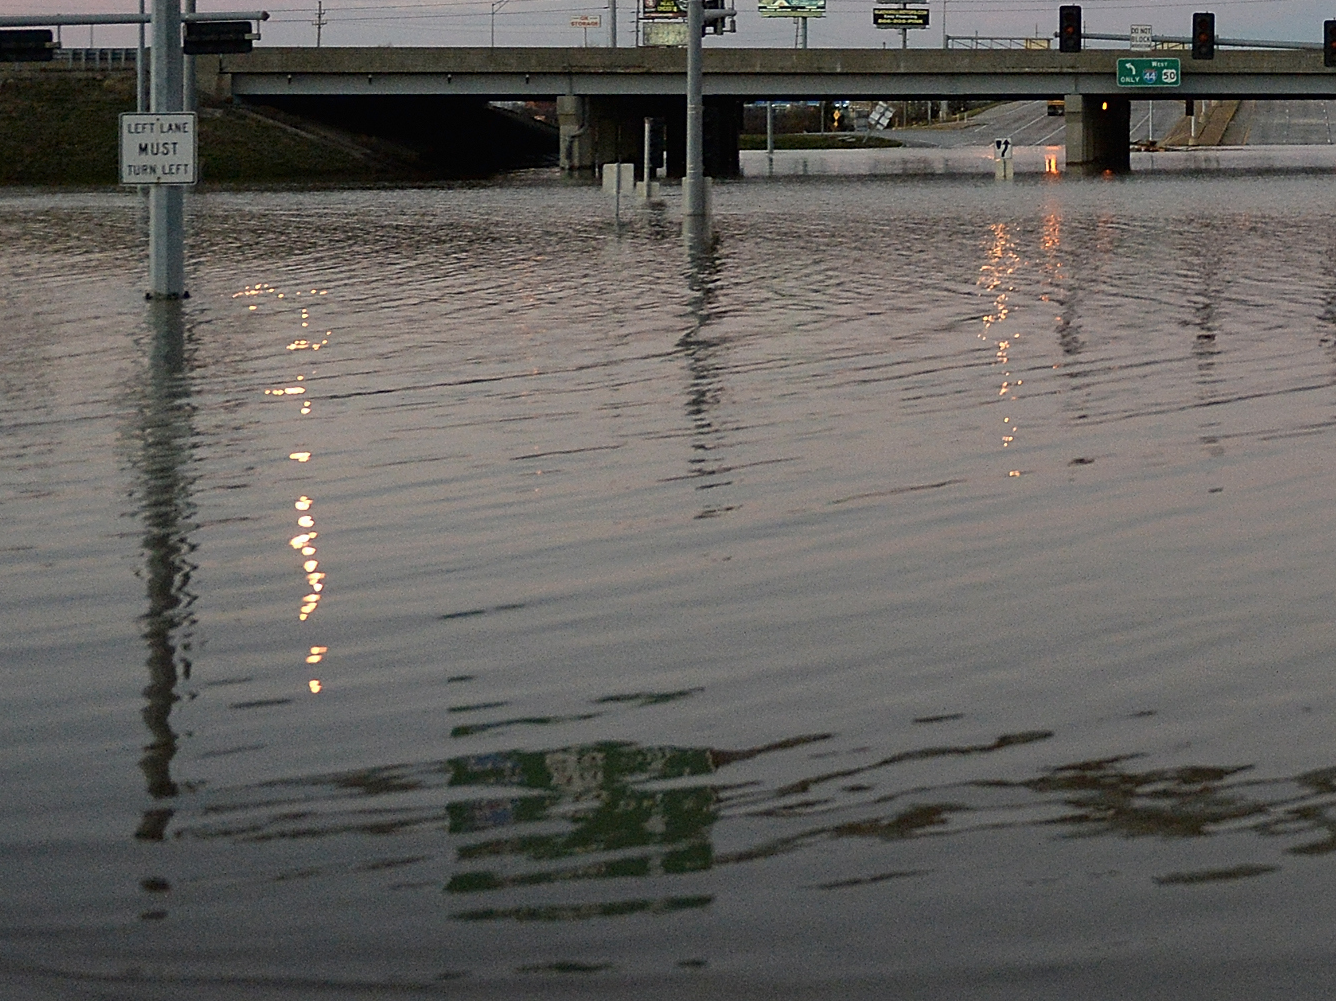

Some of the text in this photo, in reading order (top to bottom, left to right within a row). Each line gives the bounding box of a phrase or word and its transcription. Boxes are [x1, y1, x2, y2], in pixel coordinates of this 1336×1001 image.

[1145, 72, 1156, 80] 44
[1163, 71, 1176, 80] 50
[127, 122, 189, 134] LEFT LANE
[138, 141, 178, 156] MUST
[127, 163, 189, 176] TURN LEFT
